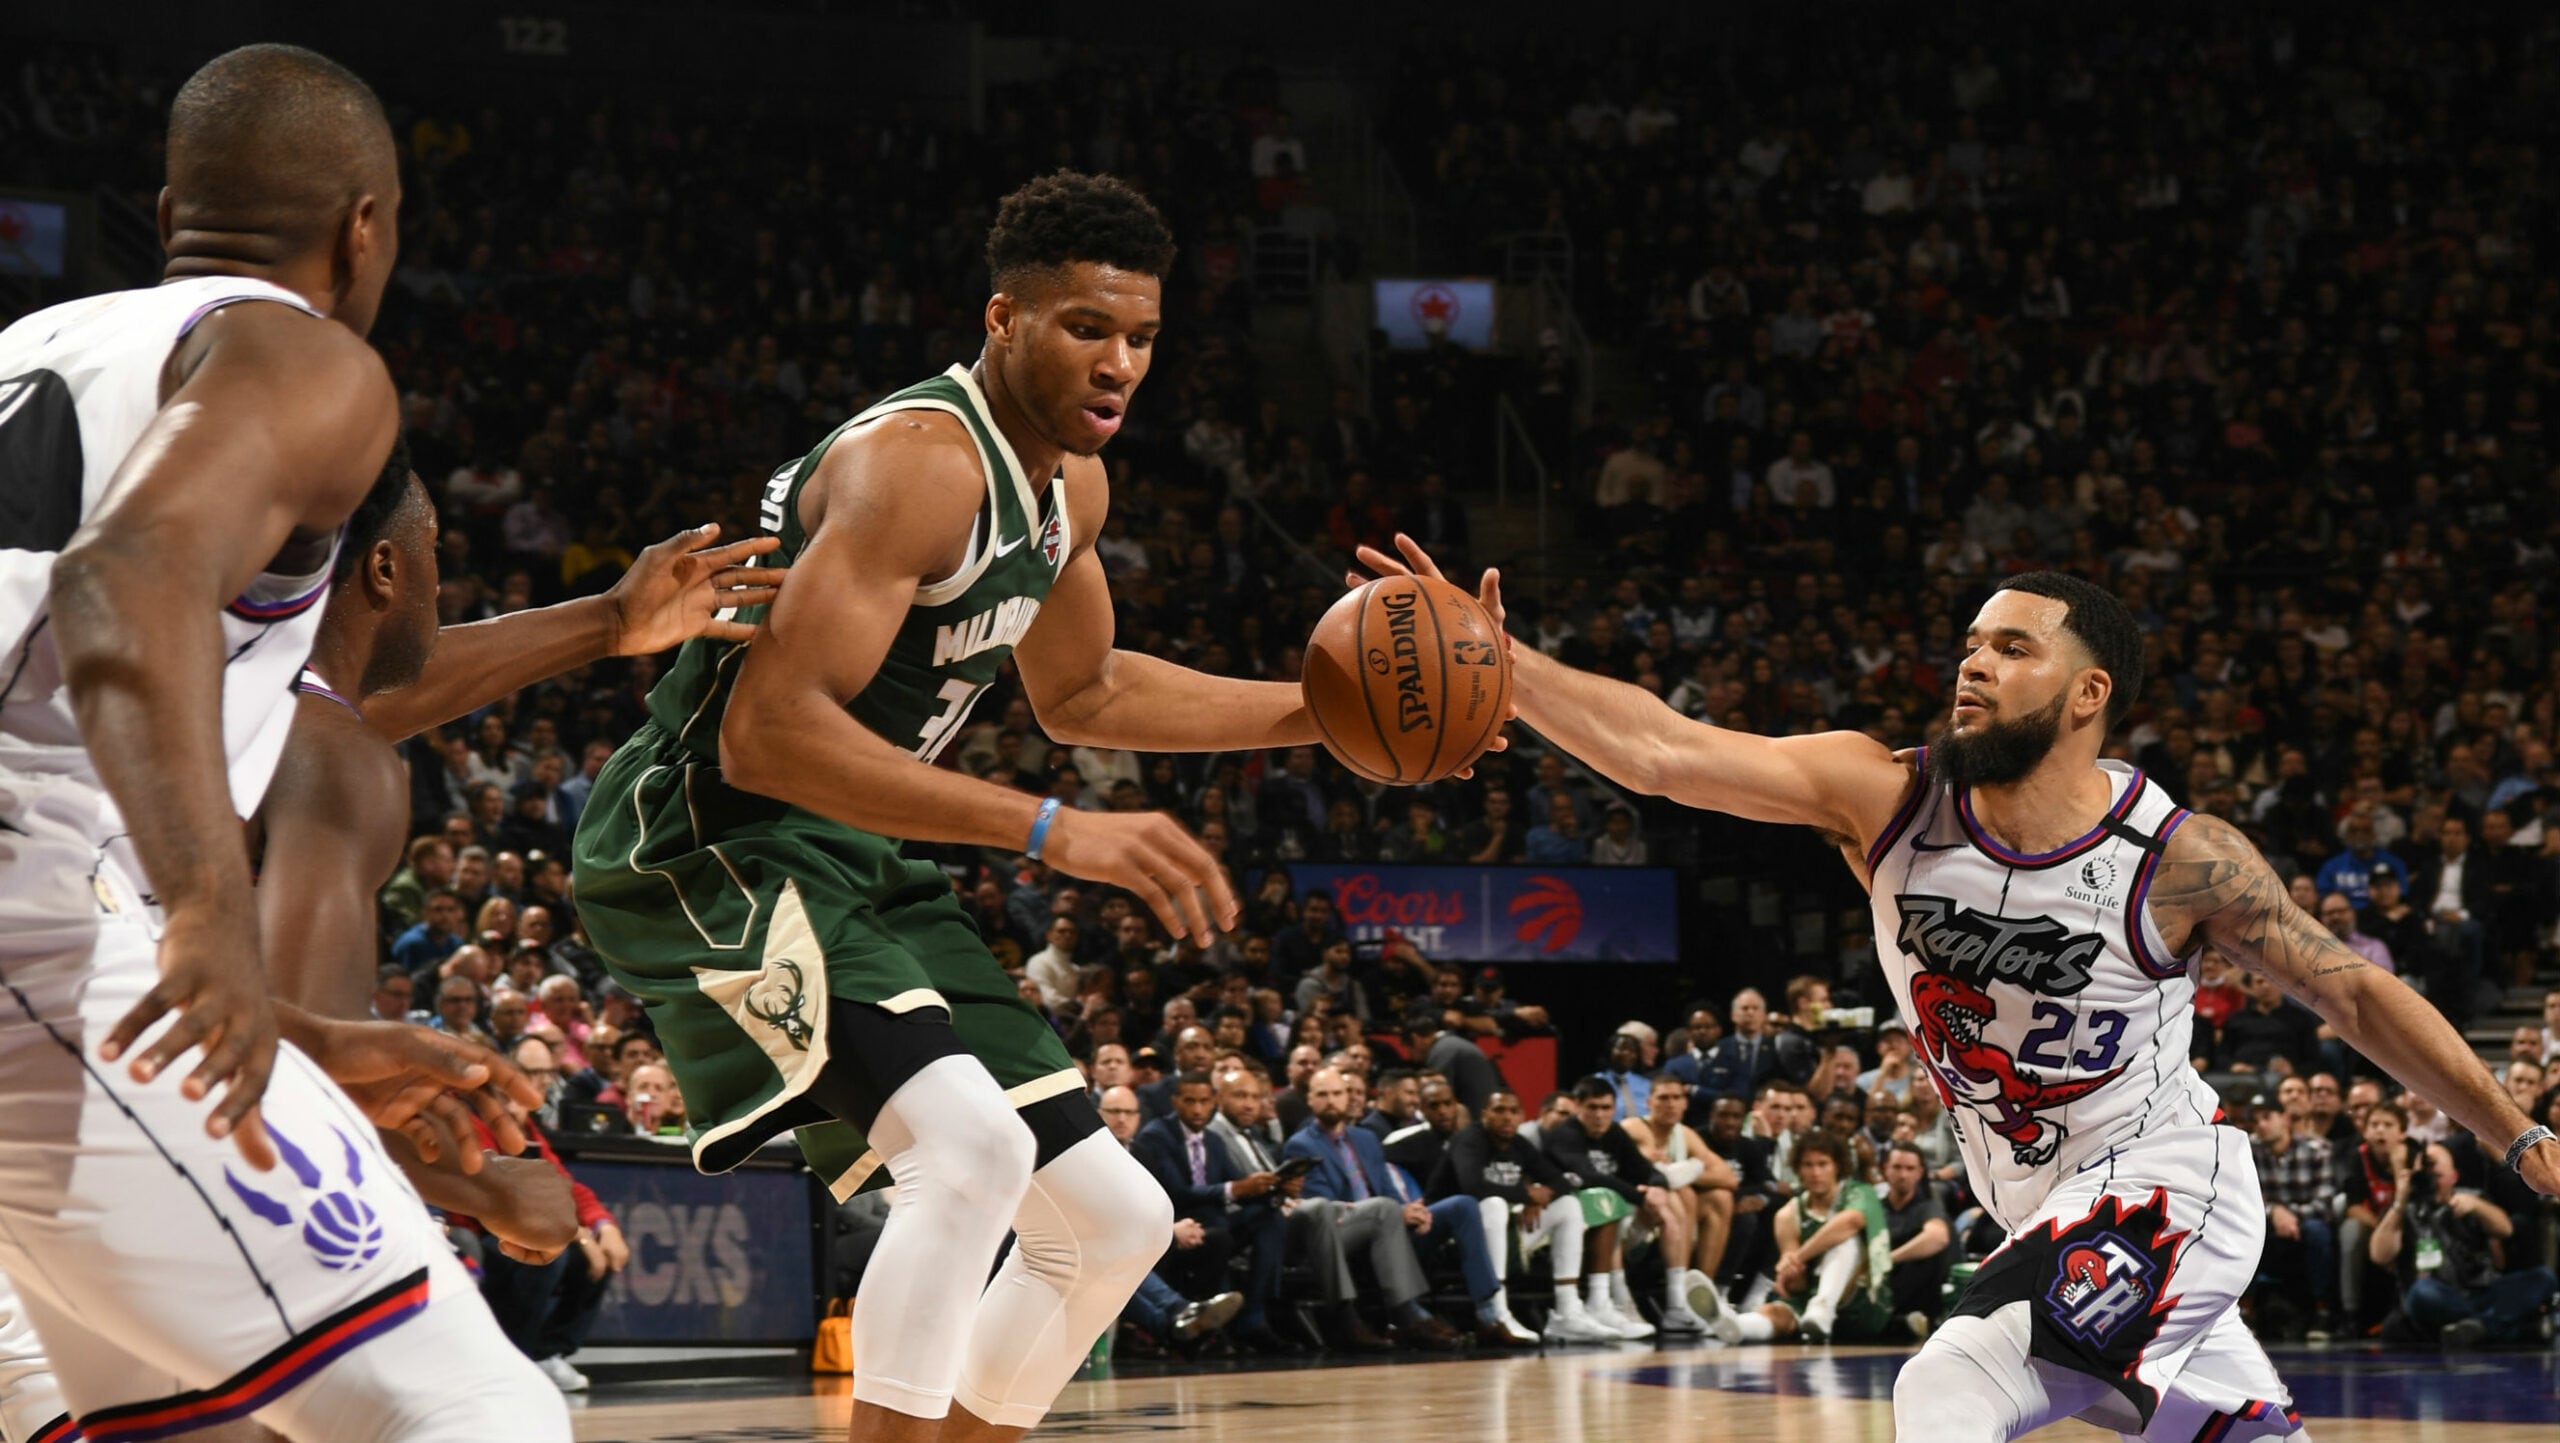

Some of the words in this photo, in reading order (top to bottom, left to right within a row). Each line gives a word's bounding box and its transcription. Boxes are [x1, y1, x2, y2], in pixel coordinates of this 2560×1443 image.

[498, 18, 570, 54] 122
[1382, 590, 1434, 733] SPALDING
[1332, 873, 1466, 924] Coors
[2065, 886, 2091, 902] Sun
[2094, 893, 2119, 910] Life
[2017, 1000, 2130, 1072] 23
